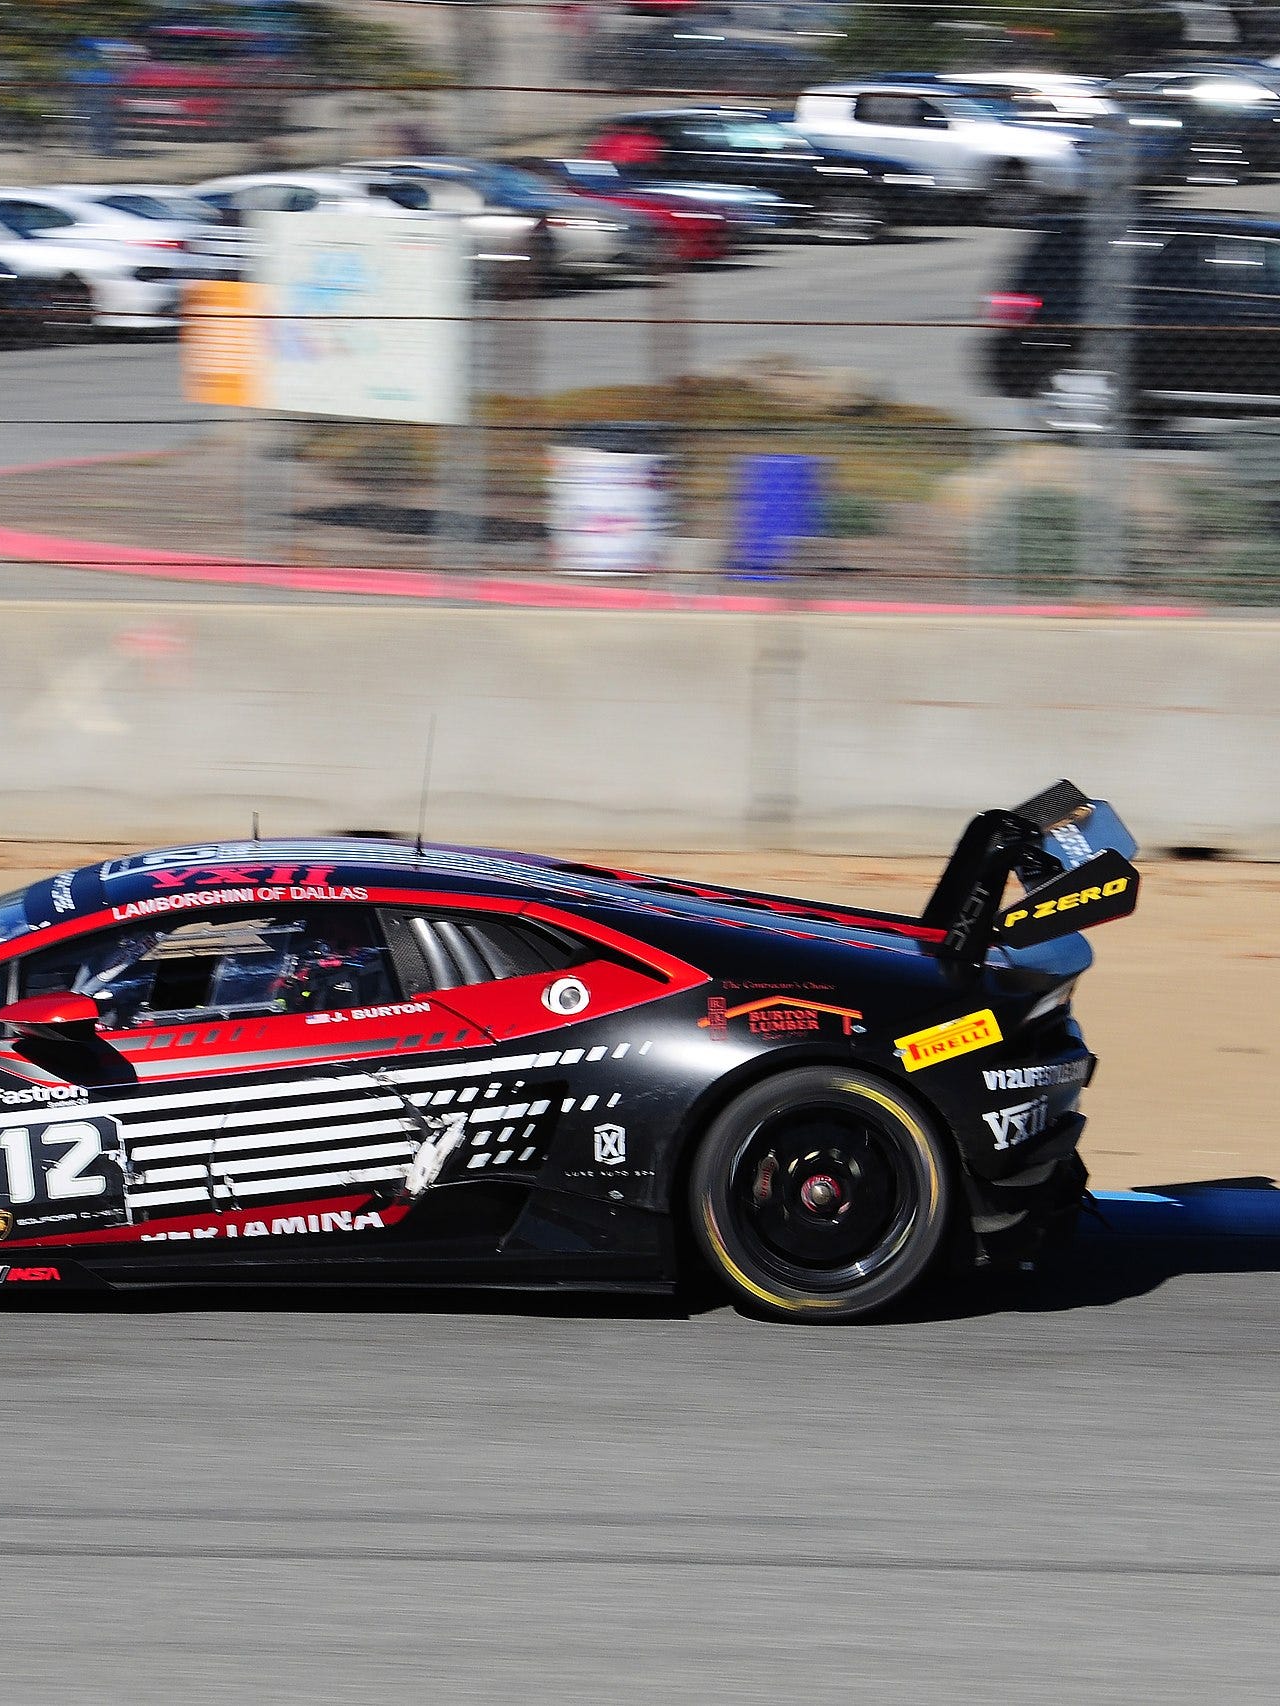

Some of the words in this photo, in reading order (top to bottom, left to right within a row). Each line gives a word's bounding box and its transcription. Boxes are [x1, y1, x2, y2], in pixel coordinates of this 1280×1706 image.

[112, 887, 254, 920] LAMBORGHINI
[257, 887, 287, 900] OF
[290, 887, 368, 900] DALLAS
[1004, 909, 1028, 927] P
[1033, 878, 1128, 918] ZERO
[351, 1002, 431, 1020] BURTON
[749, 1009, 818, 1022] BURTON
[750, 1020, 819, 1033] LUMBER
[908, 1019, 990, 1061] PIRELLI
